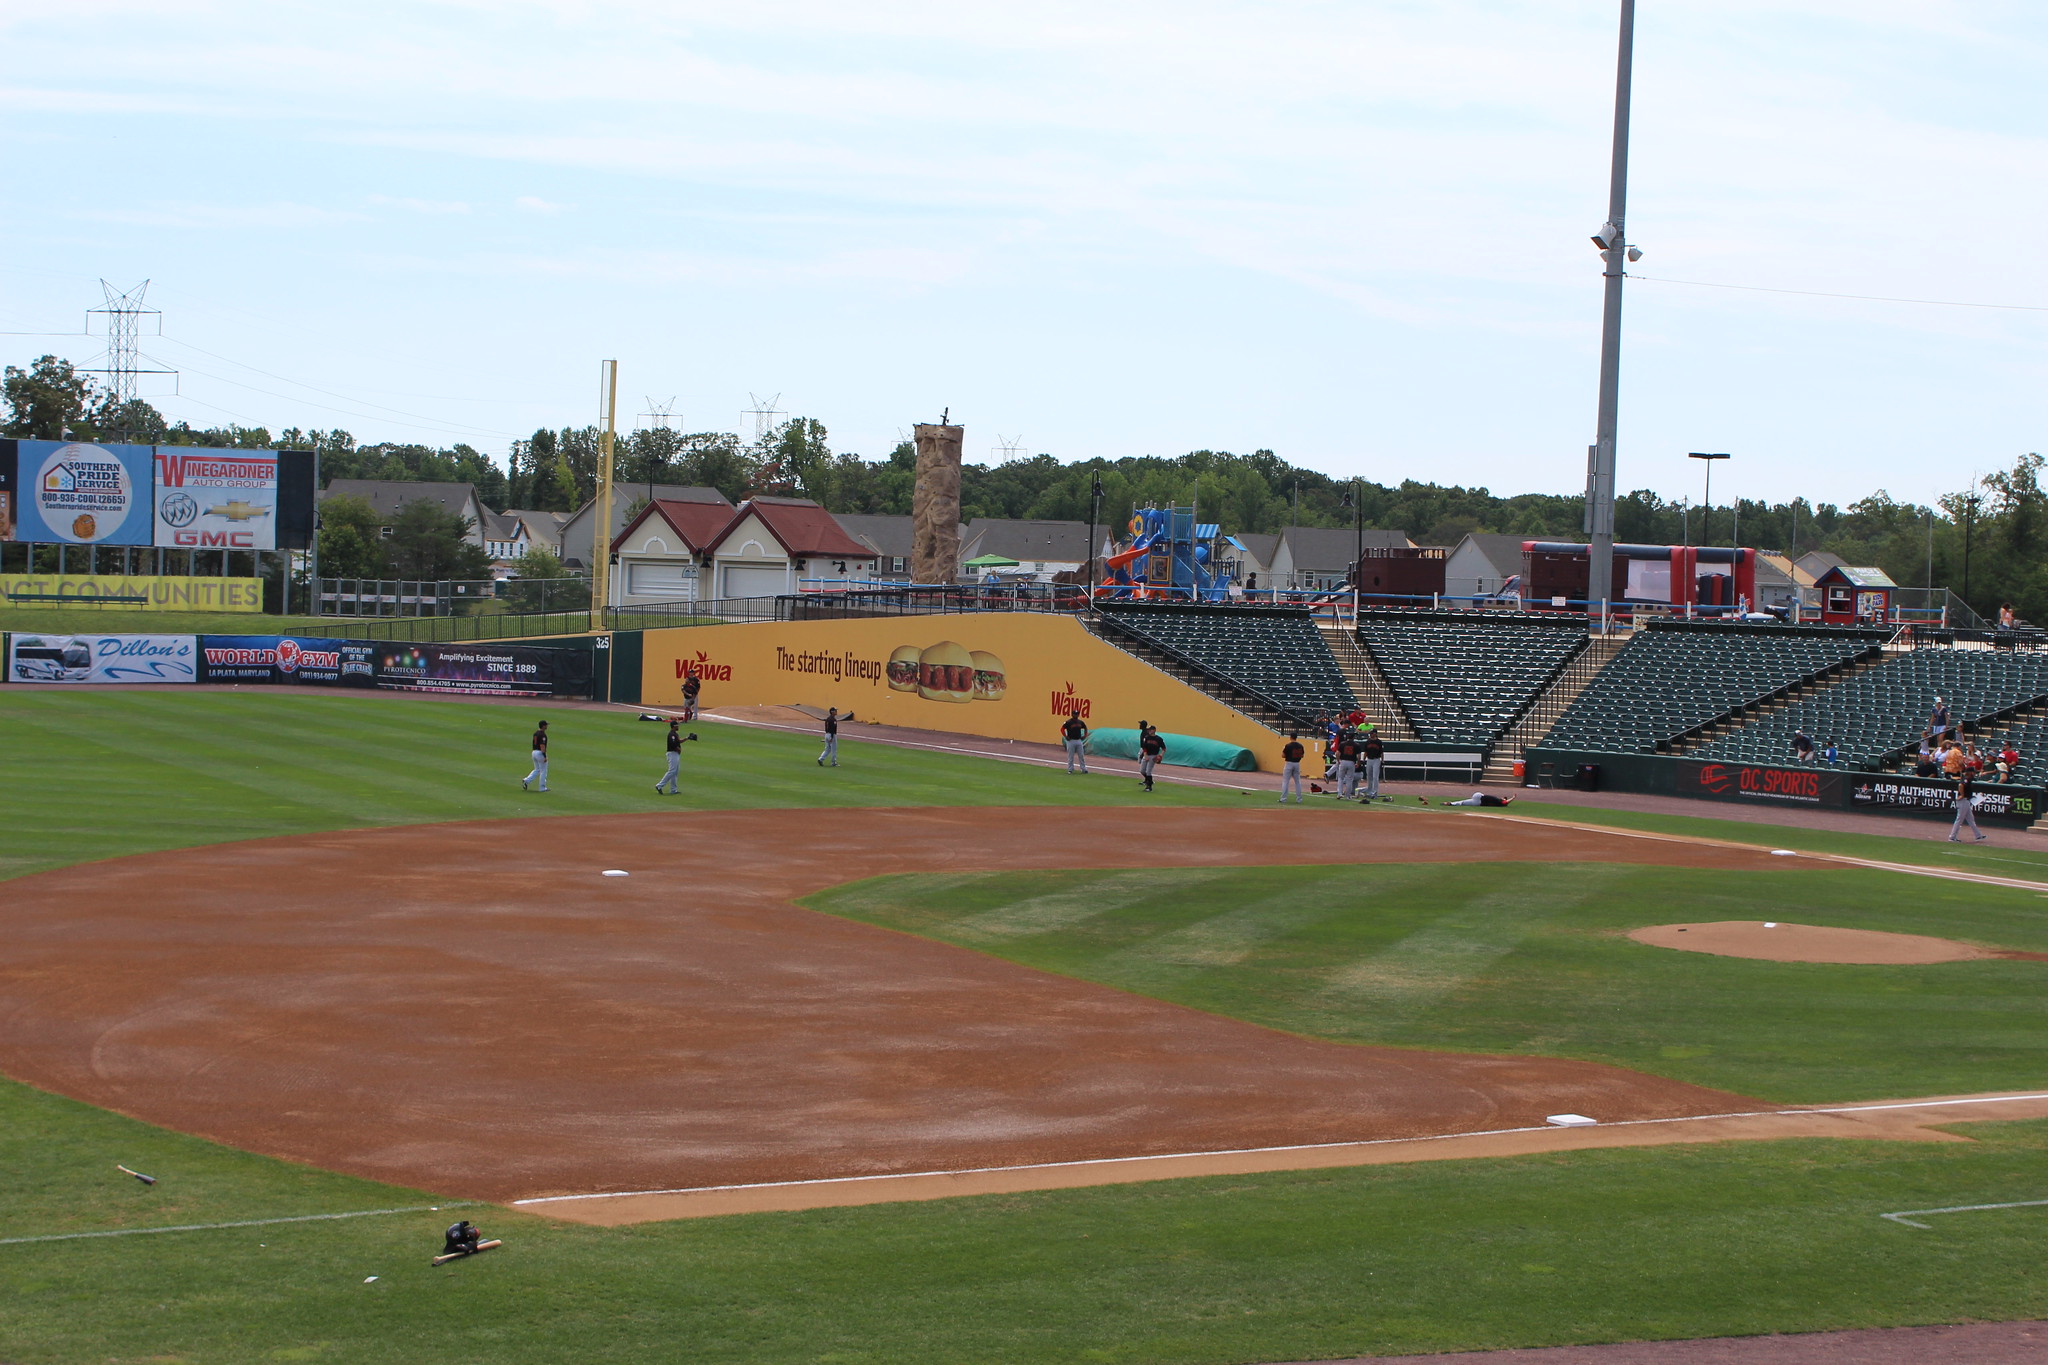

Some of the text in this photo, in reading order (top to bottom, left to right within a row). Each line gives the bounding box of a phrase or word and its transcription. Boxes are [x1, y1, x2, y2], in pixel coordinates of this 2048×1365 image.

[69, 462, 120, 472] SOUTHERN
[161, 455, 274, 487] WINEGARDNER
[77, 471, 119, 480] PRIDE
[77, 480, 119, 489] SERVICE
[192, 479, 267, 488] AUTO GROUP
[42, 493, 125, 504] 800-936-COOL (2665)
[174, 530, 253, 547] GMC
[57, 581, 259, 605] COMMUNITIES
[97, 638, 191, 657] Dillon's
[596, 637, 609, 649] 325
[204, 649, 340, 669] WORLD GYM
[438, 653, 513, 663] Amplifying Excitement
[238, 669, 270, 677] MARYLAND
[383, 666, 426, 674] PYROTECNICO
[487, 663, 536, 673] SINCE 1889
[675, 659, 732, 681] Wawa
[776, 646, 881, 686] The starting lineup
[1051, 691, 1091, 718] Wawa
[1740, 768, 1819, 796] OC SPORTS
[1874, 783, 1898, 794] ALPB
[1899, 785, 1952, 799] AUTHENTIC
[1876, 794, 1895, 803] IT'S
[1898, 795, 1918, 805] NOT
[1921, 798, 1946, 808] JUST
